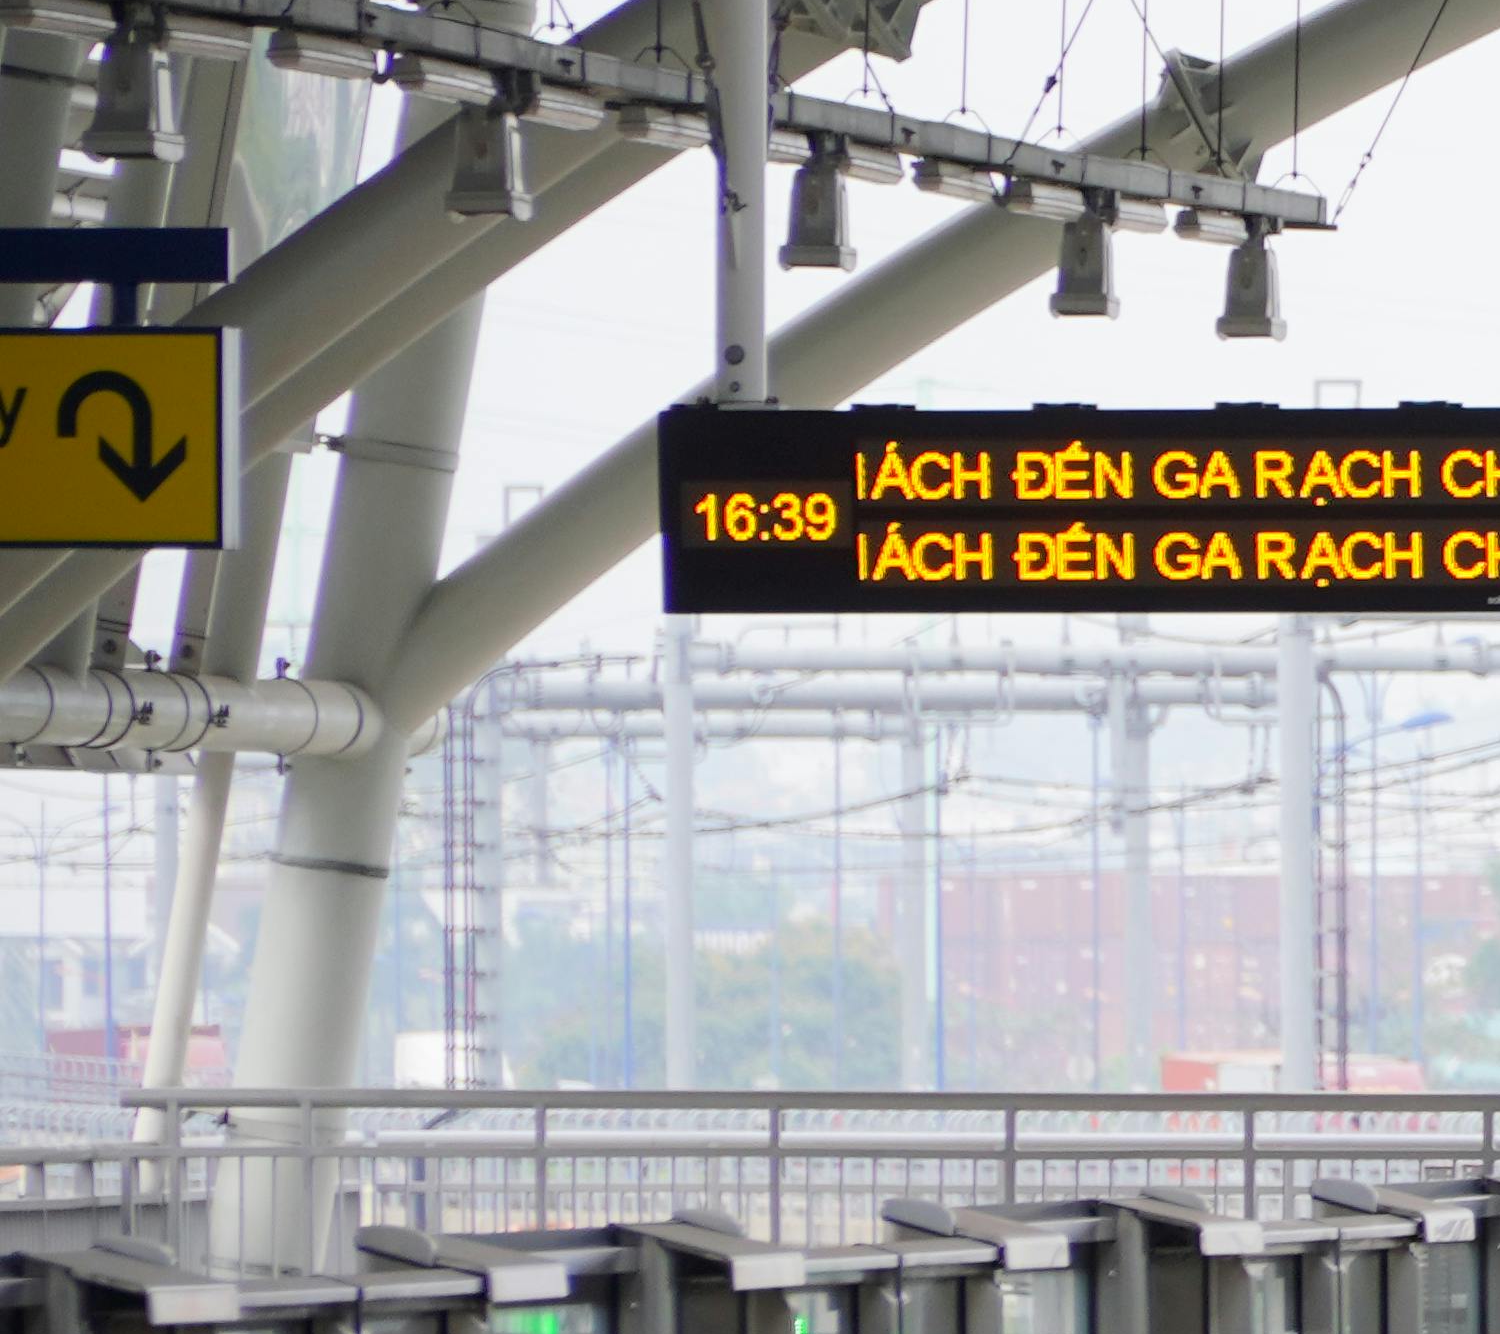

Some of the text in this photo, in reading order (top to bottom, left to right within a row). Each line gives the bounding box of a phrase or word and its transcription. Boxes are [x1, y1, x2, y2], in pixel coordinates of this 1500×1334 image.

[1010, 440, 1134, 499] ĐẾN
[1152, 450, 1241, 499] GA
[1254, 450, 1422, 507] RẠCH
[694, 492, 837, 542] 16:39
[1011, 522, 1136, 581] ĐẾN
[1153, 531, 1243, 581] GA
[1255, 531, 1424, 588] RẠCH
